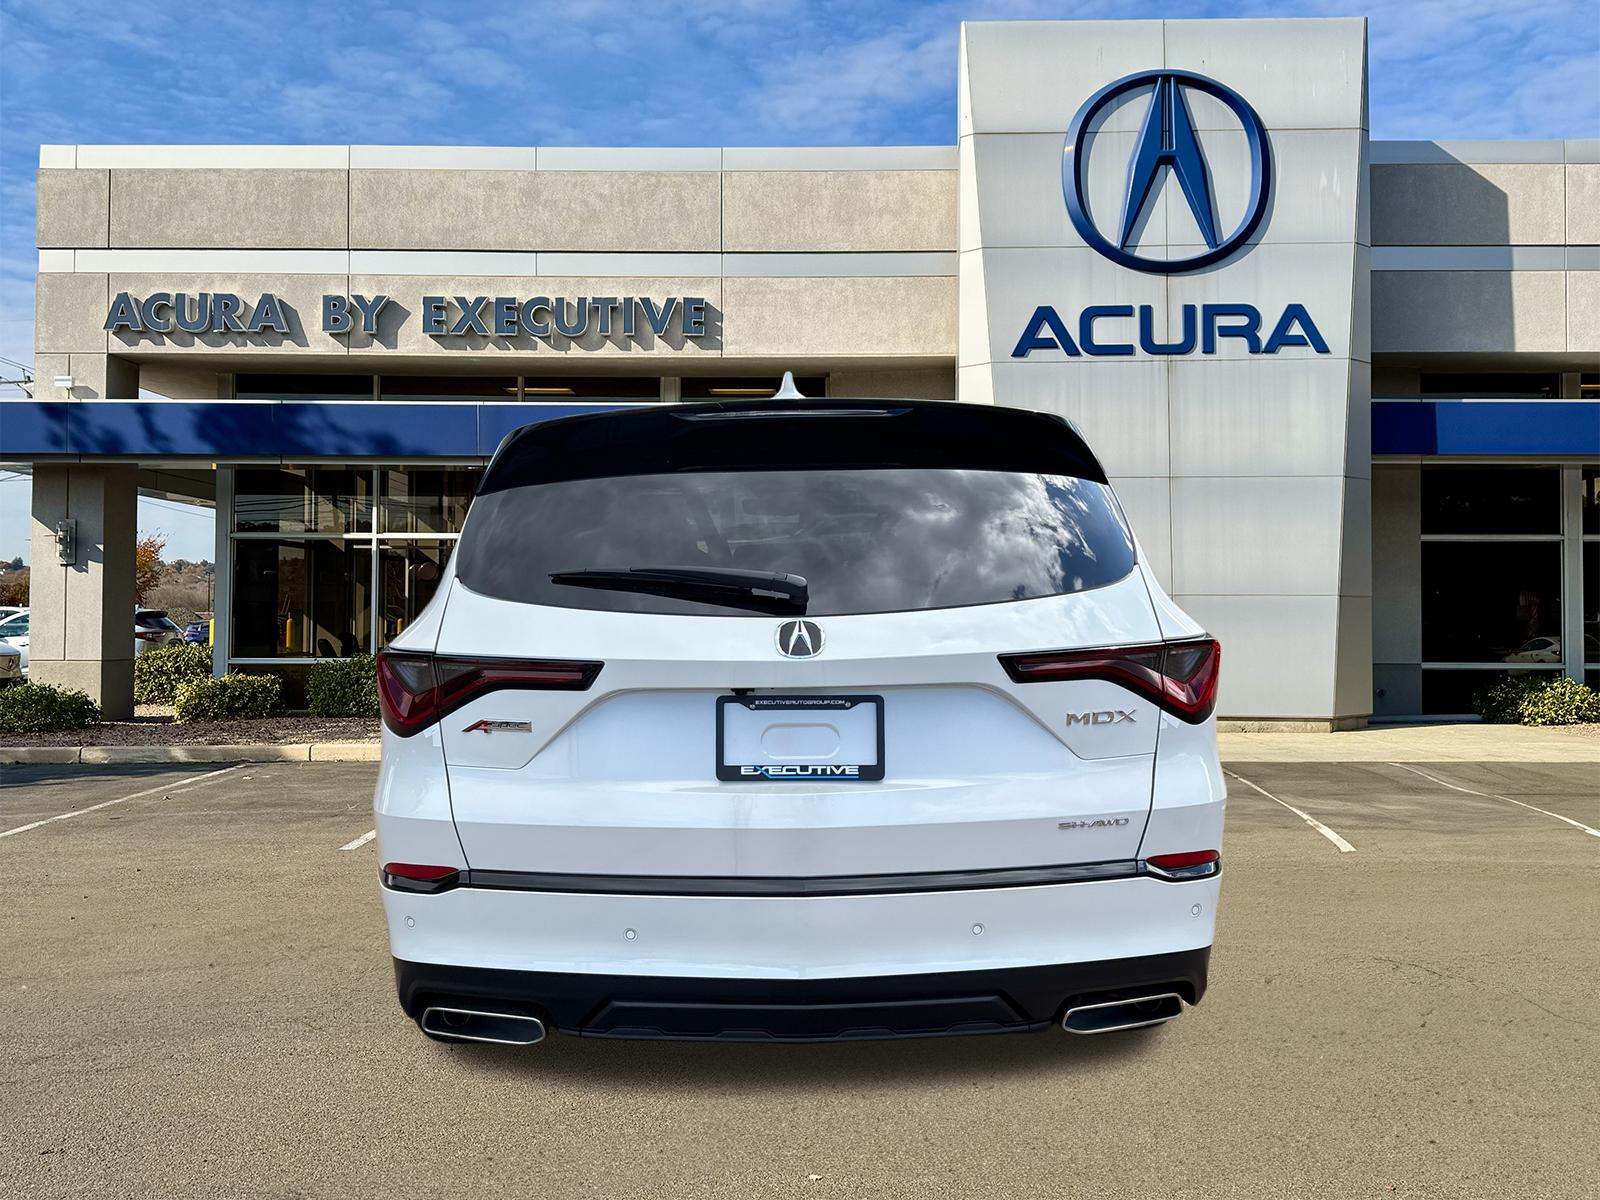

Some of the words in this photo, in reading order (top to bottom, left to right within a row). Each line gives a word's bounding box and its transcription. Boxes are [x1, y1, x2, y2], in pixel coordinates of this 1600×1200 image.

[103, 292, 289, 334] ACURA
[321, 295, 391, 335] BY
[422, 296, 707, 338] EXECUTIVE
[1011, 303, 1332, 357] ACURA
[1066, 709, 1137, 727] MDX
[740, 765, 860, 777] EXECUTIVE
